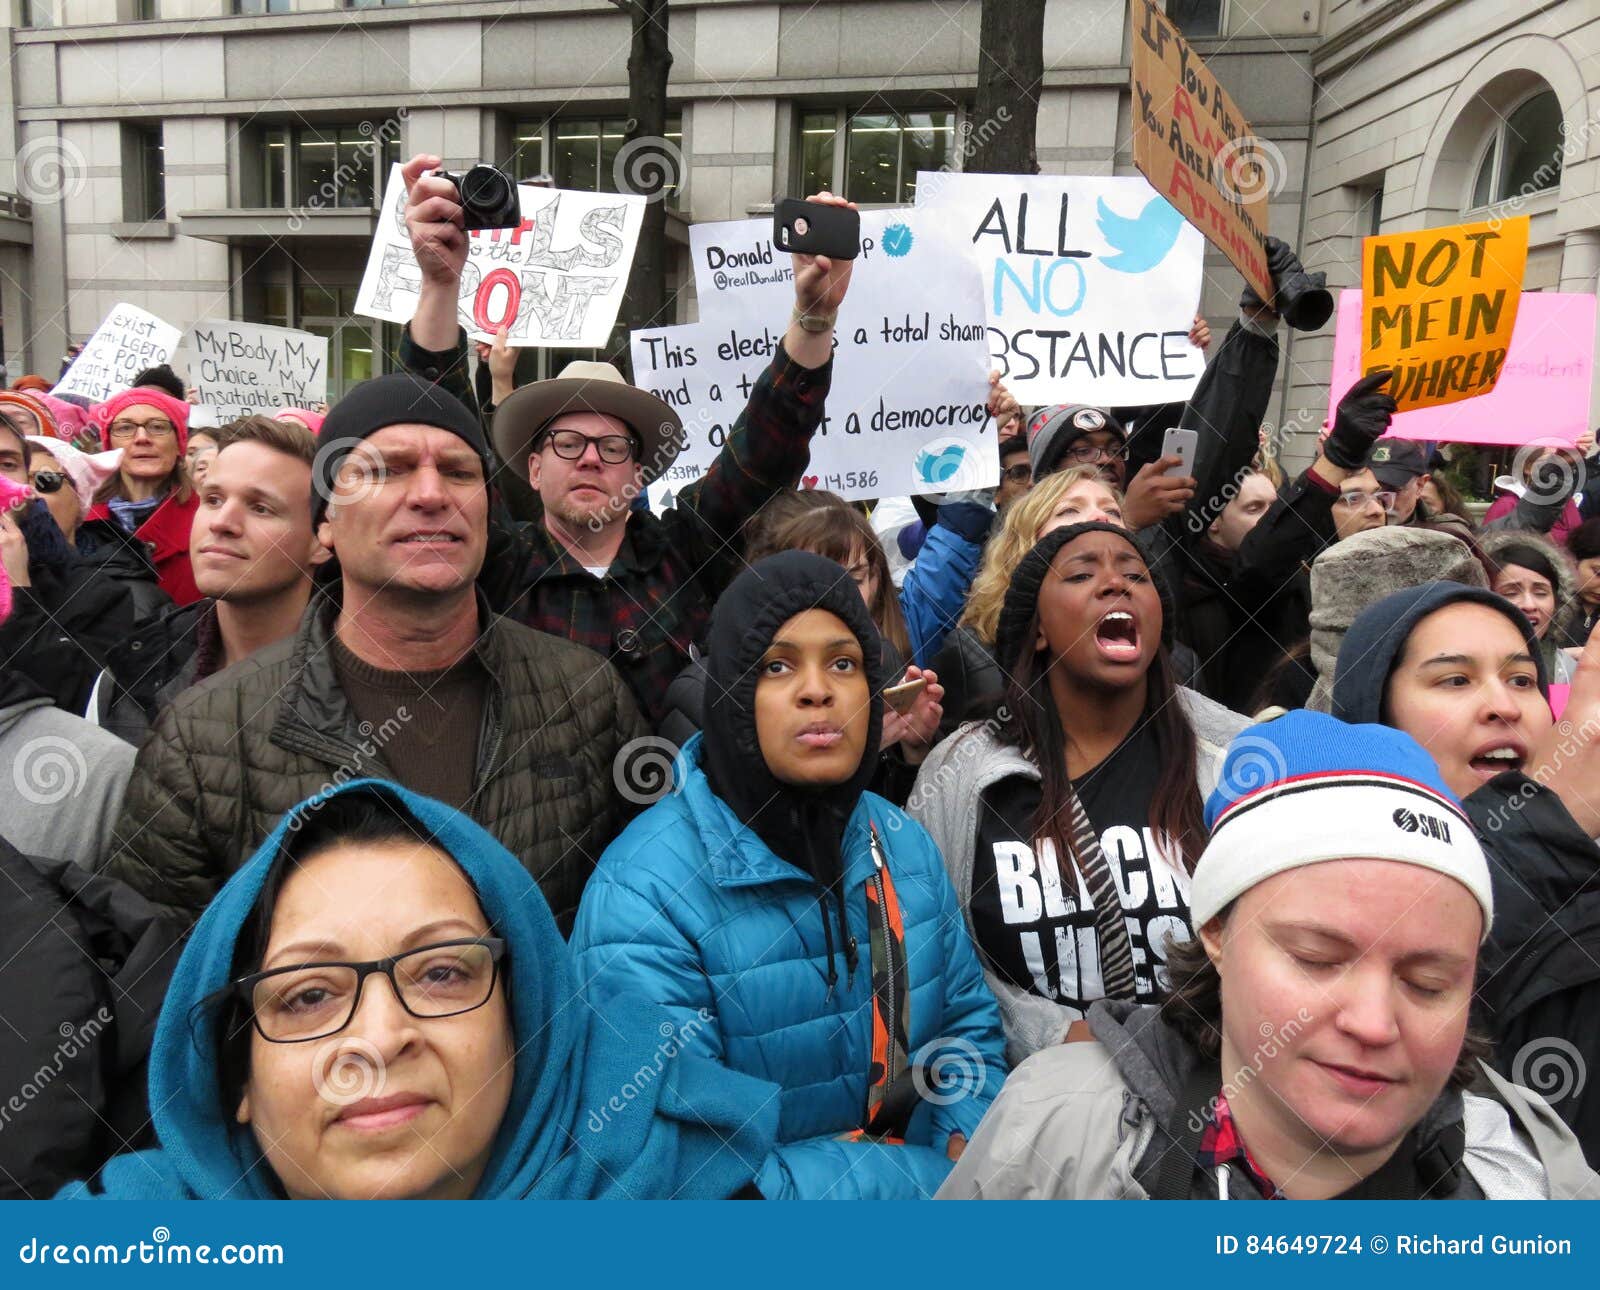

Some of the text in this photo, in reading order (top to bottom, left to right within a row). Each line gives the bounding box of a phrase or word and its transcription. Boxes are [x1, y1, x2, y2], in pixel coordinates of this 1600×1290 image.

[1168, 118, 1204, 180] ARE
[972, 192, 1092, 258] ALL
[489, 239, 522, 263] the
[707, 240, 773, 270] Donald
[1374, 232, 1502, 297] NOT
[713, 268, 794, 290] @realDonaldTr
[993, 257, 1087, 317] NO
[1370, 289, 1506, 350] MEIN
[195, 329, 227, 362] My
[285, 339, 320, 382] My
[640, 336, 698, 370] This
[717, 327, 779, 361] electi
[853, 327, 868, 344] a
[880, 312, 930, 343] total
[939, 313, 985, 342] sham
[987, 328, 1196, 381] BSTANCE
[280, 370, 306, 398] My
[1504, 354, 1585, 378] esident
[200, 385, 281, 408] Insatiable
[709, 383, 722, 402] a
[845, 411, 861, 434] a
[871, 396, 992, 434] democracy
[824, 470, 879, 490] 14,586
